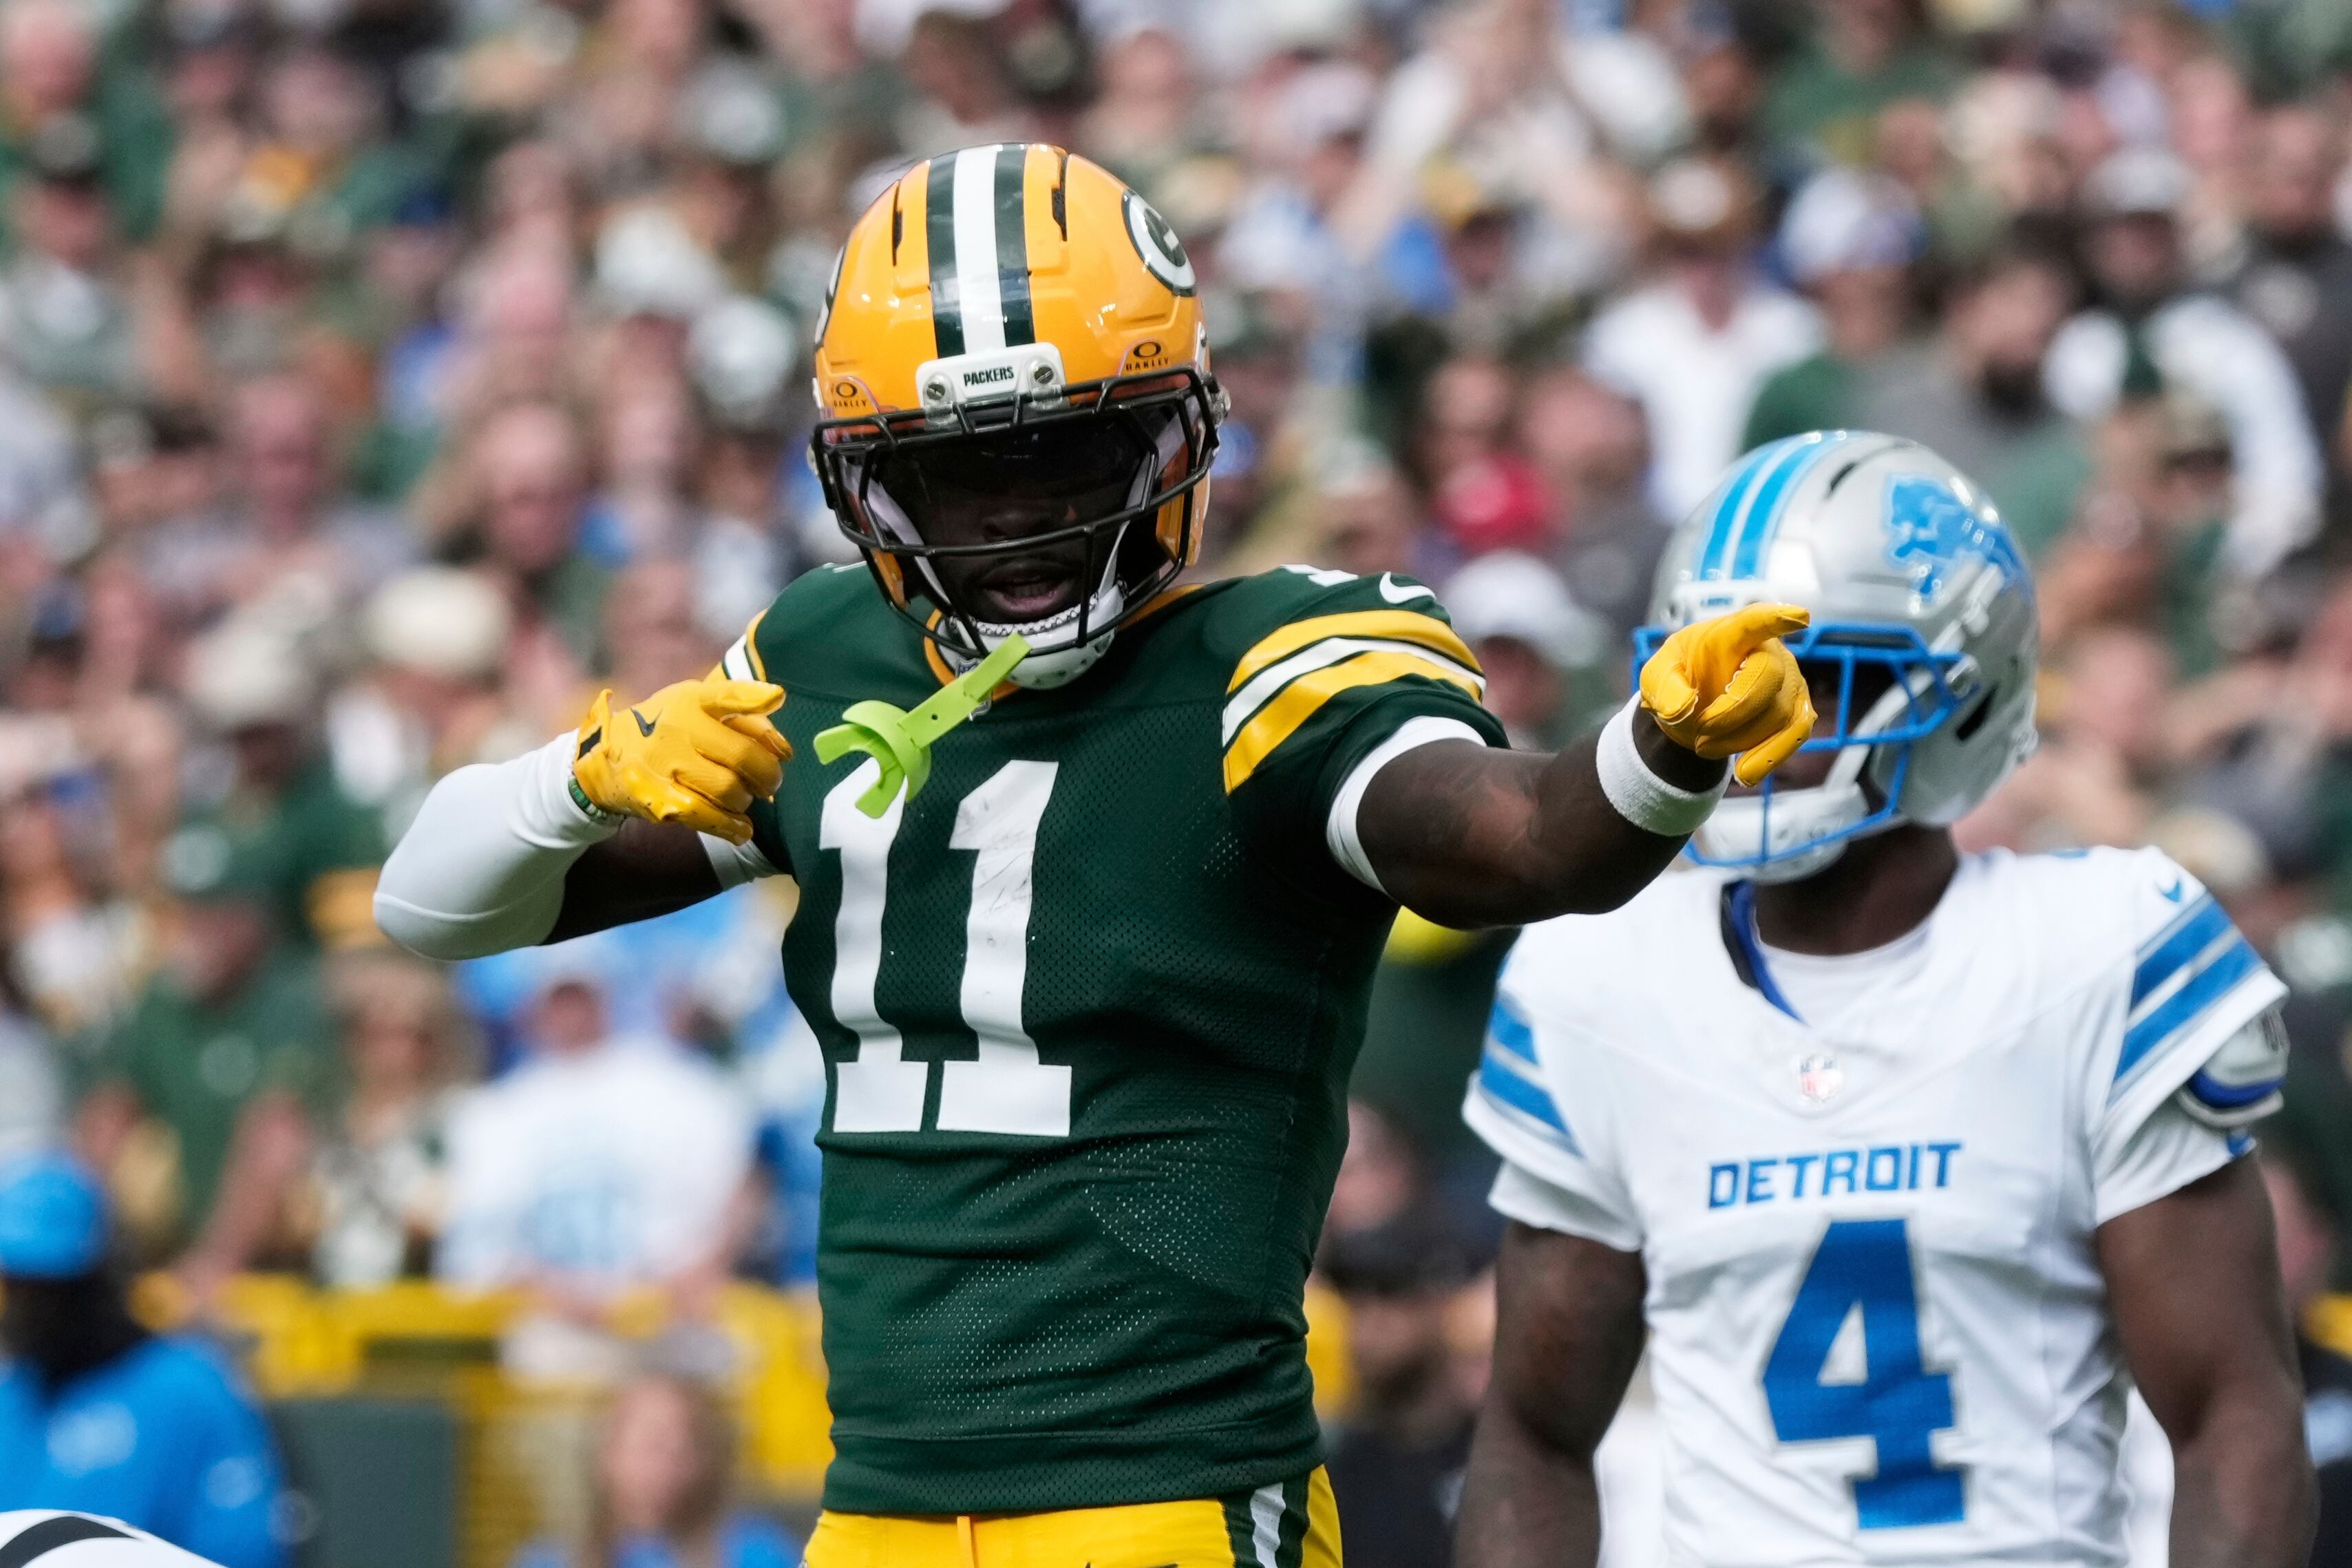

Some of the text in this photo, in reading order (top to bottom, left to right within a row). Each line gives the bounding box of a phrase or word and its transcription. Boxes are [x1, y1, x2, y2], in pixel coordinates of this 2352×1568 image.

[963, 365, 1015, 387] PACKERS
[1126, 357, 1169, 370] OAKLEY
[820, 757, 1072, 1137] 11
[1708, 1141, 1964, 1209] DETROIT
[1761, 1217, 1967, 1531] 4
